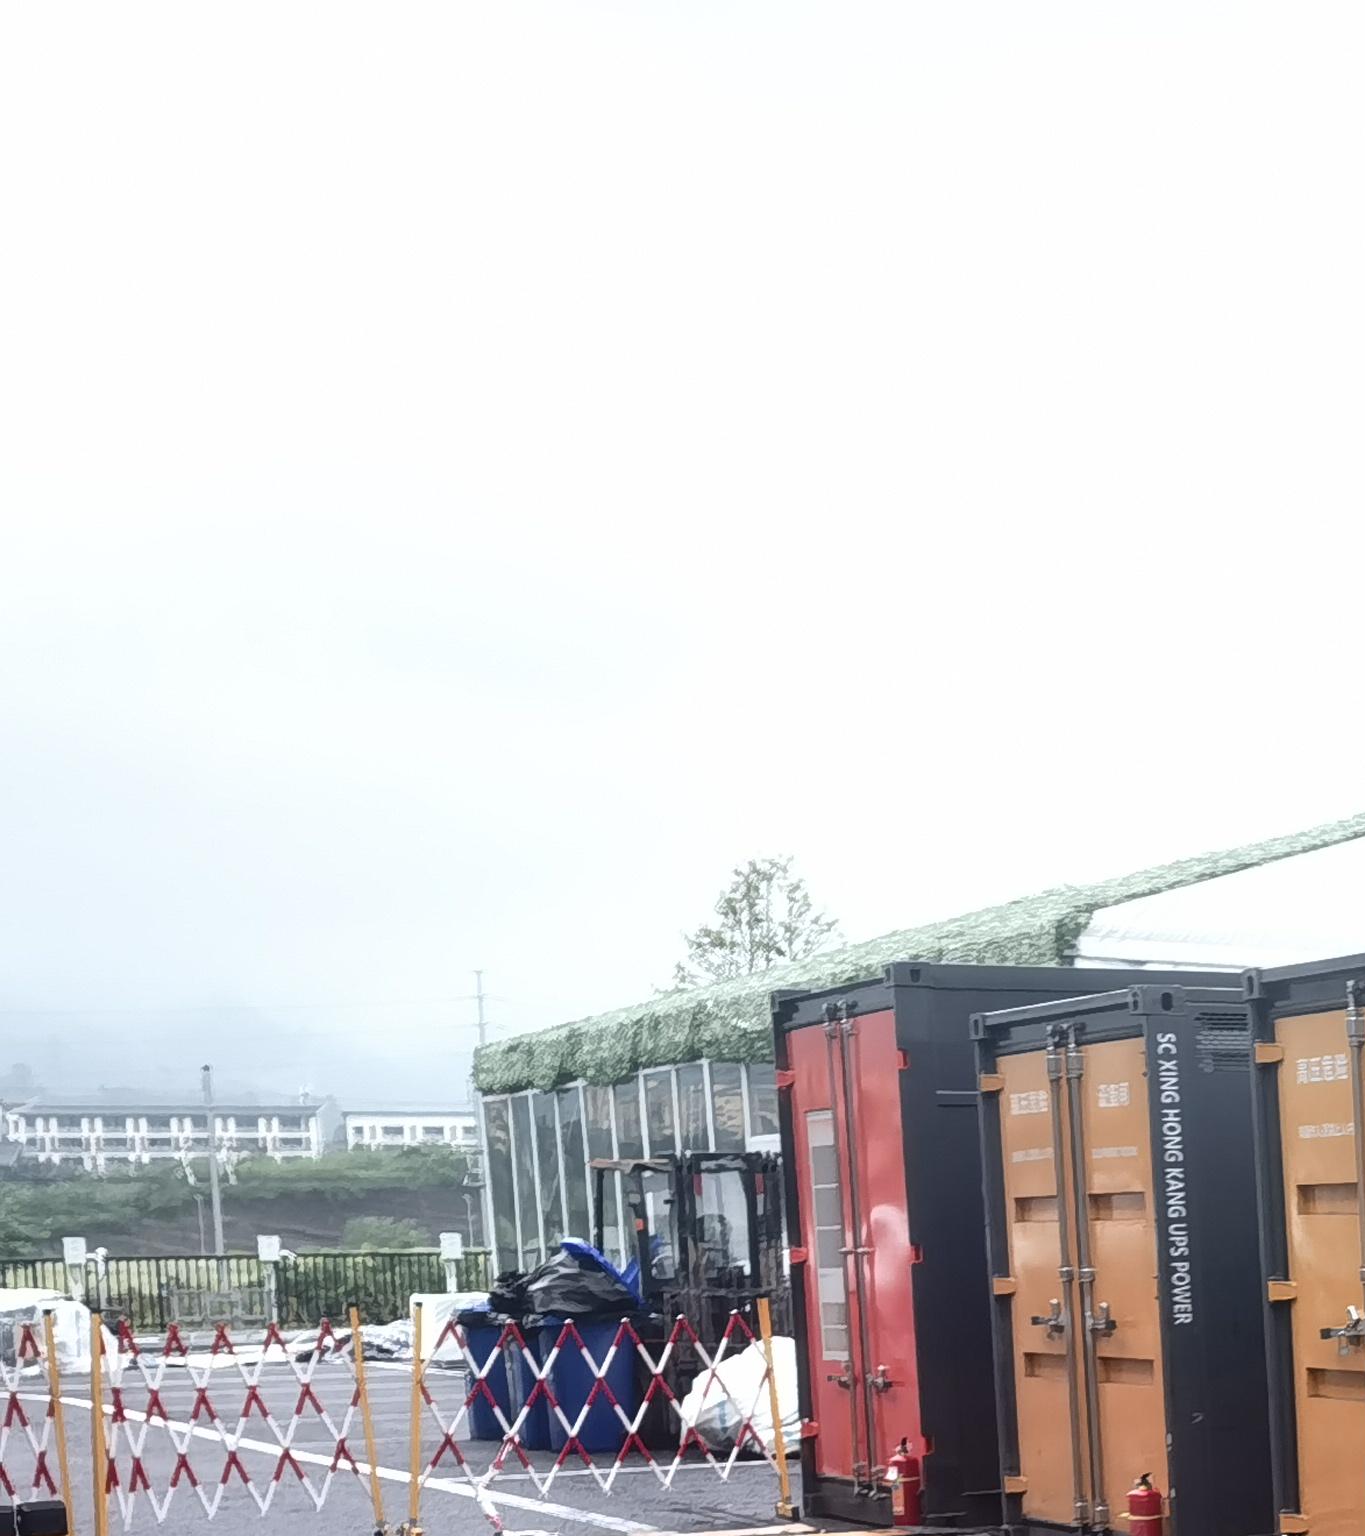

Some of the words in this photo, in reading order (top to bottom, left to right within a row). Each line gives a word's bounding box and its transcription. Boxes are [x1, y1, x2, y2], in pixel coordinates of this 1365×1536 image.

[1156, 1032, 1178, 1055] SC
[1157, 1059, 1181, 1104] XING
[1160, 1108, 1185, 1162] HONG
[1163, 1167, 1188, 1218] KANG
[1167, 1223, 1190, 1257] UPS
[1170, 1261, 1193, 1325] POWER
